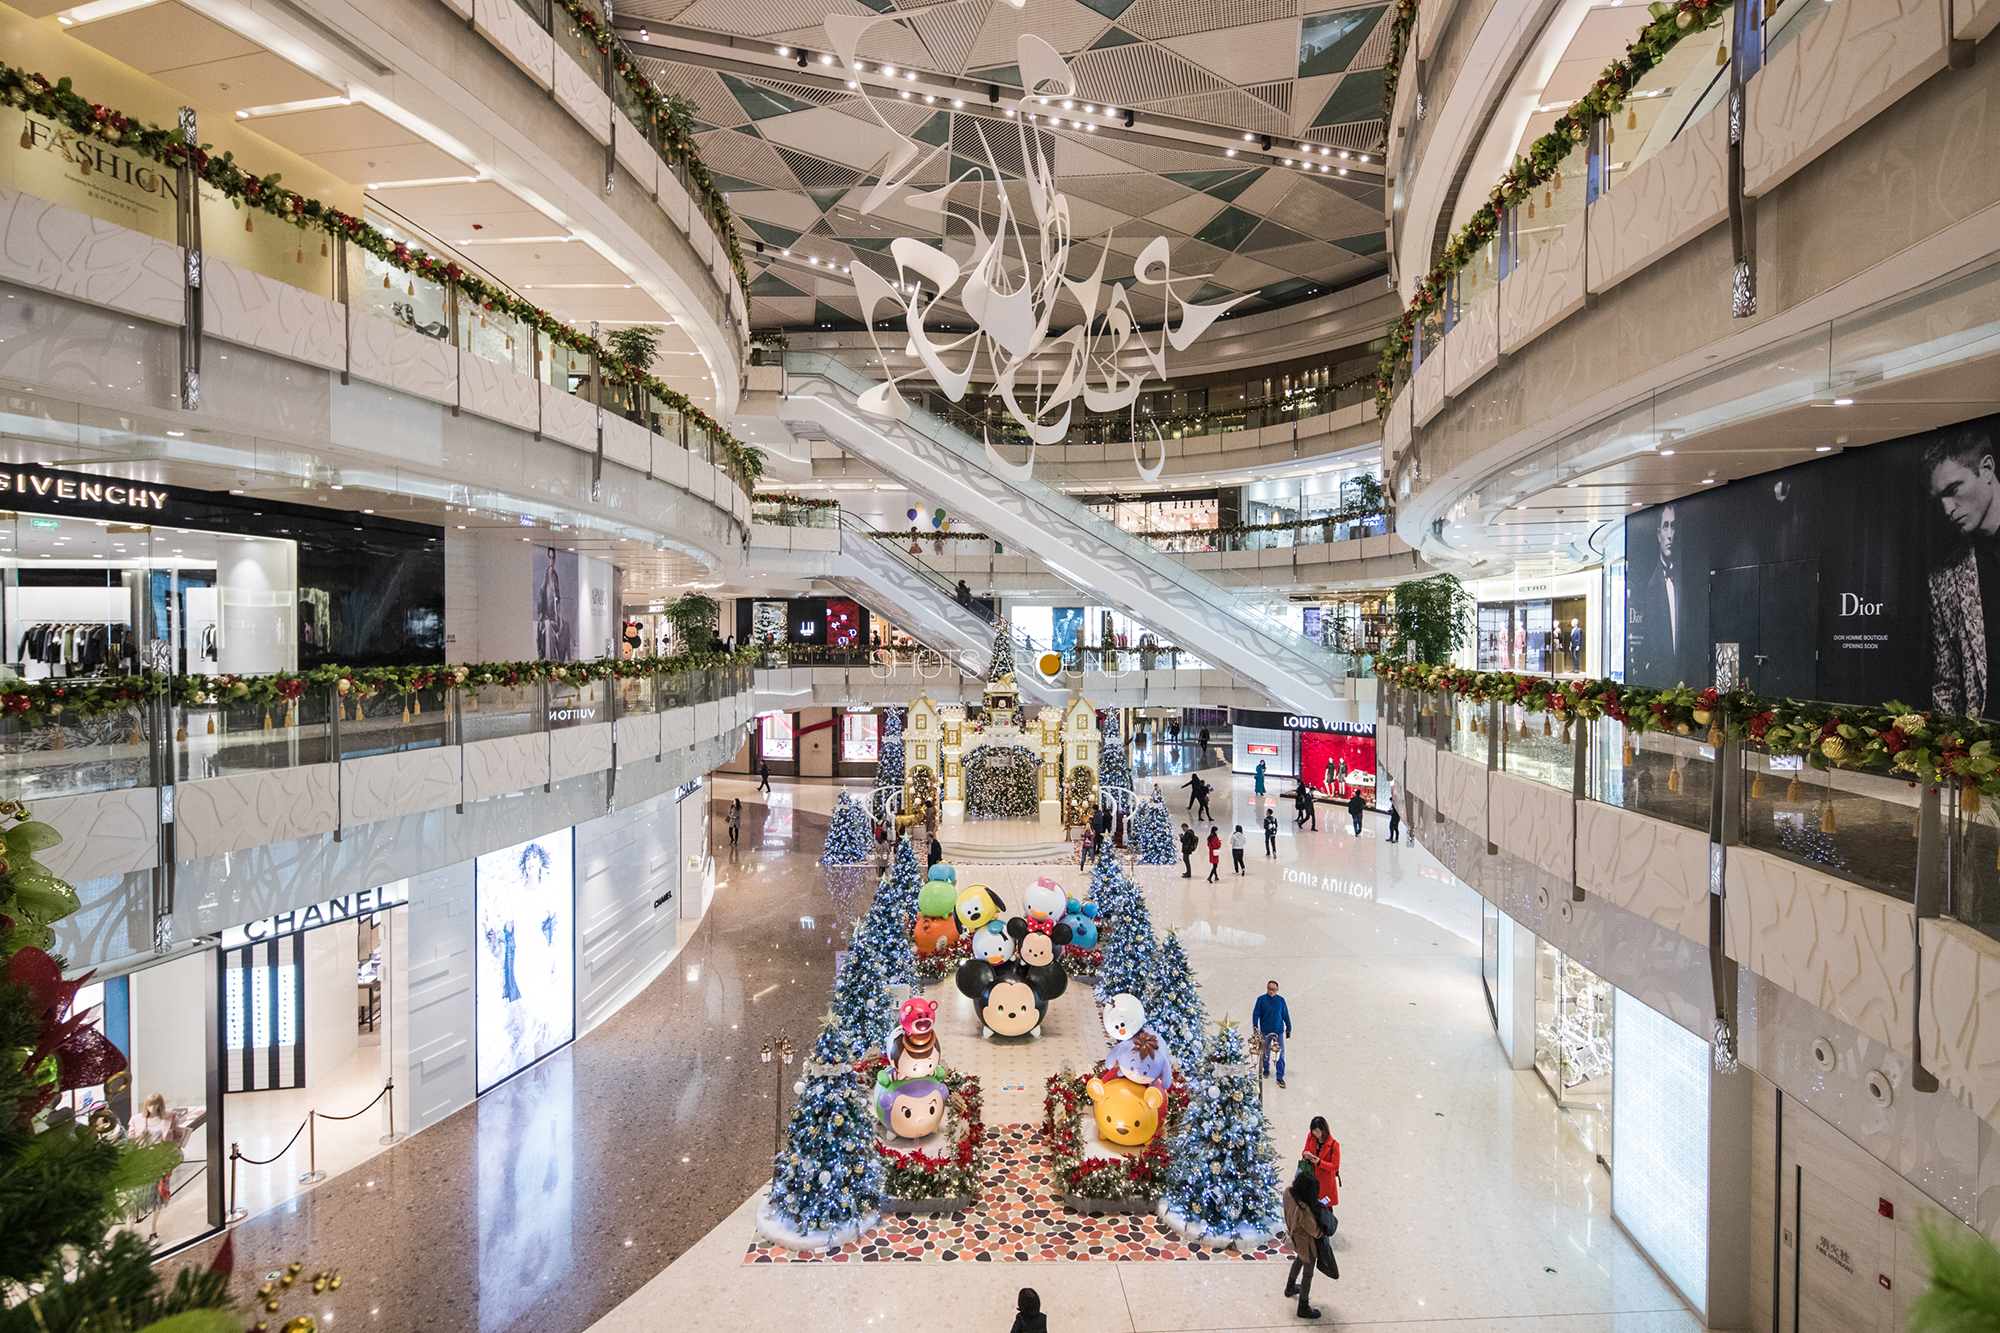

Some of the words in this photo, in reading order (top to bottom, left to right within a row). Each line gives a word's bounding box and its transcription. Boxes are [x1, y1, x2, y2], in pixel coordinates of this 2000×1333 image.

[29, 118, 178, 200] FASHION
[1518, 584, 1547, 592] ETRO
[1629, 607, 1644, 624] Dior
[1839, 592, 1884, 617] Dior
[846, 705, 874, 713] Cartier
[1283, 715, 1319, 729] LOUIS
[1321, 718, 1374, 734] VUITTON
[653, 890, 673, 909] CHANEL
[243, 886, 393, 941] CHANEL
[1816, 1244, 1829, 1257] FIRE
[1828, 1252, 1854, 1275] HYDRANT
[1820, 1235, 1850, 1265] 消火栓
